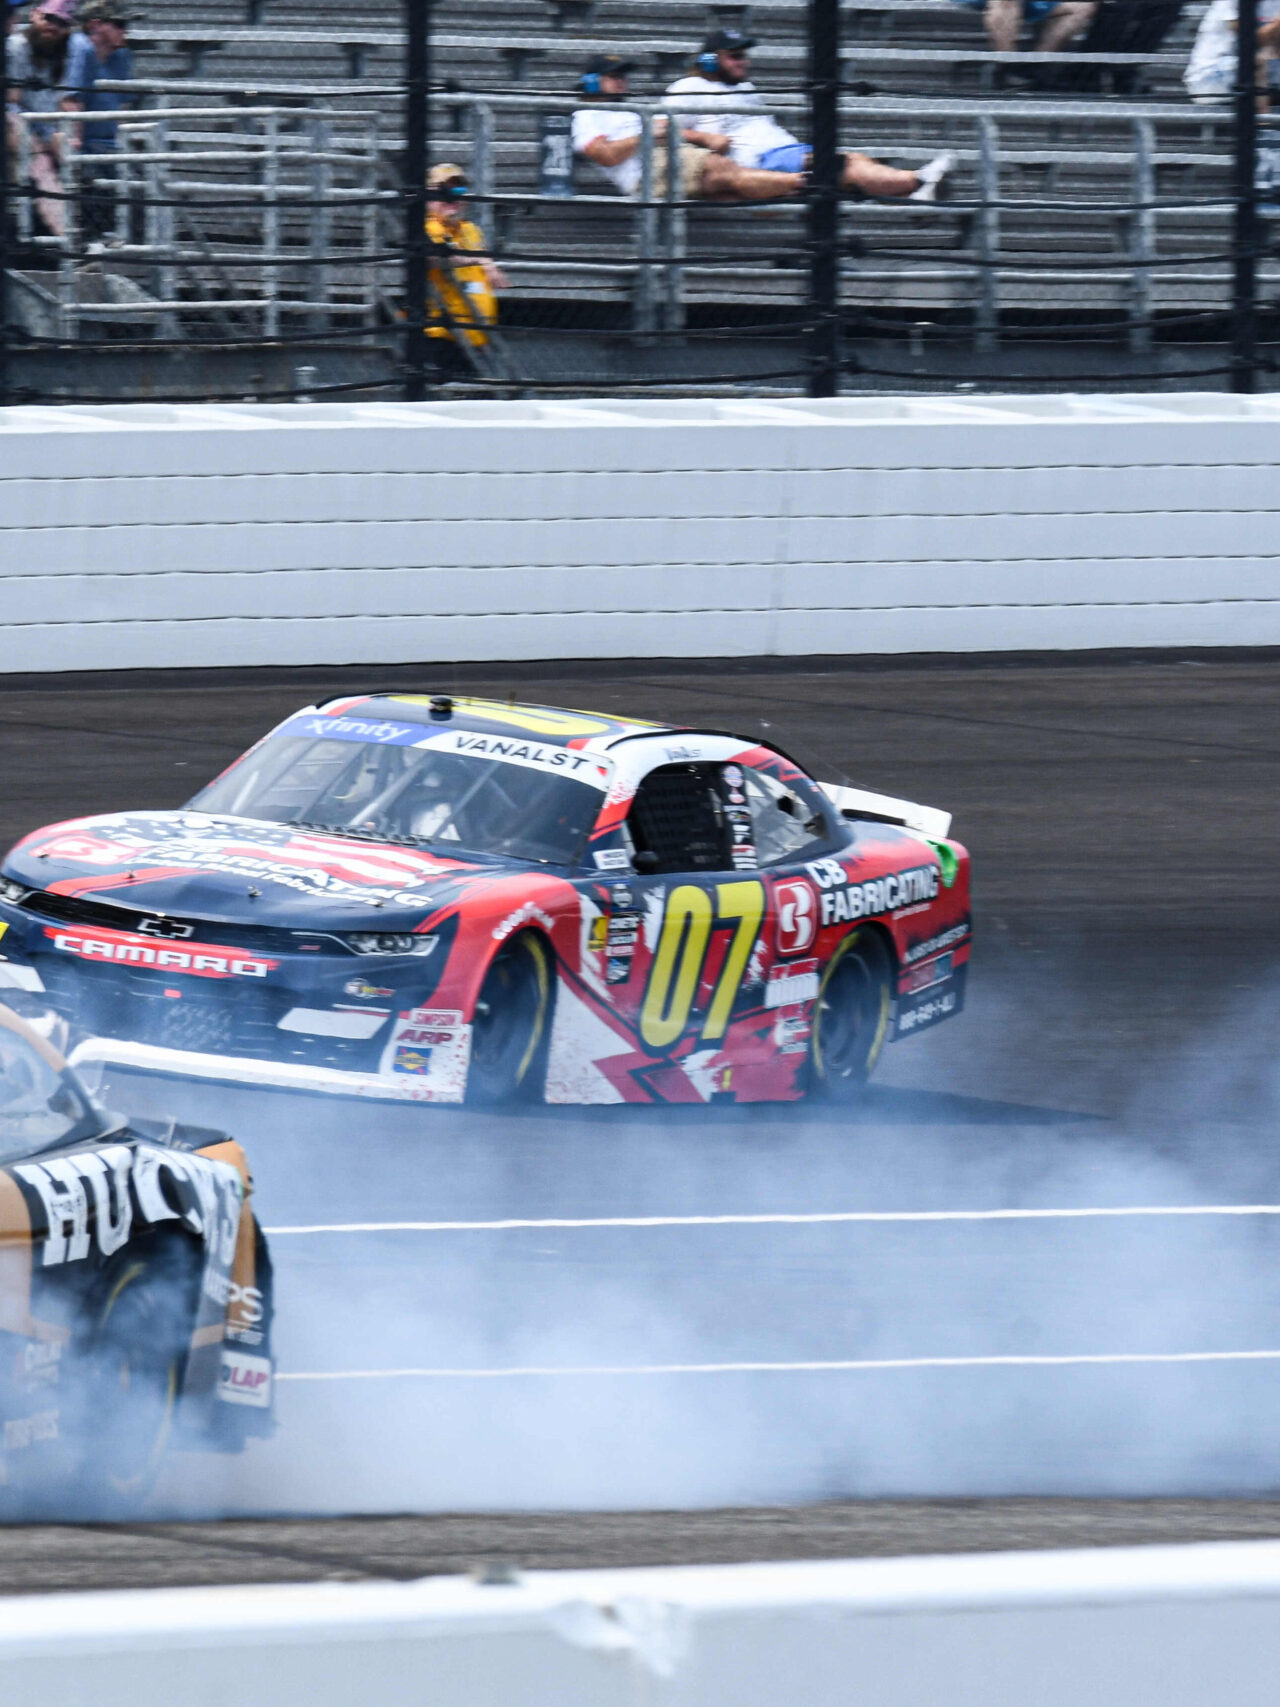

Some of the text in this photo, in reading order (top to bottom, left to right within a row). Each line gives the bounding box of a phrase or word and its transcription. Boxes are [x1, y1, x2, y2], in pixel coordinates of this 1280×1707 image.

[304, 715, 414, 741] xfinity
[457, 736, 590, 771] VANALST
[144, 849, 433, 907] FABRICATING
[806, 858, 848, 888] CB
[821, 865, 939, 926] FABRICATING
[54, 934, 268, 978] CAMARO
[640, 880, 765, 1047] 07
[396, 1029, 454, 1045] ARP
